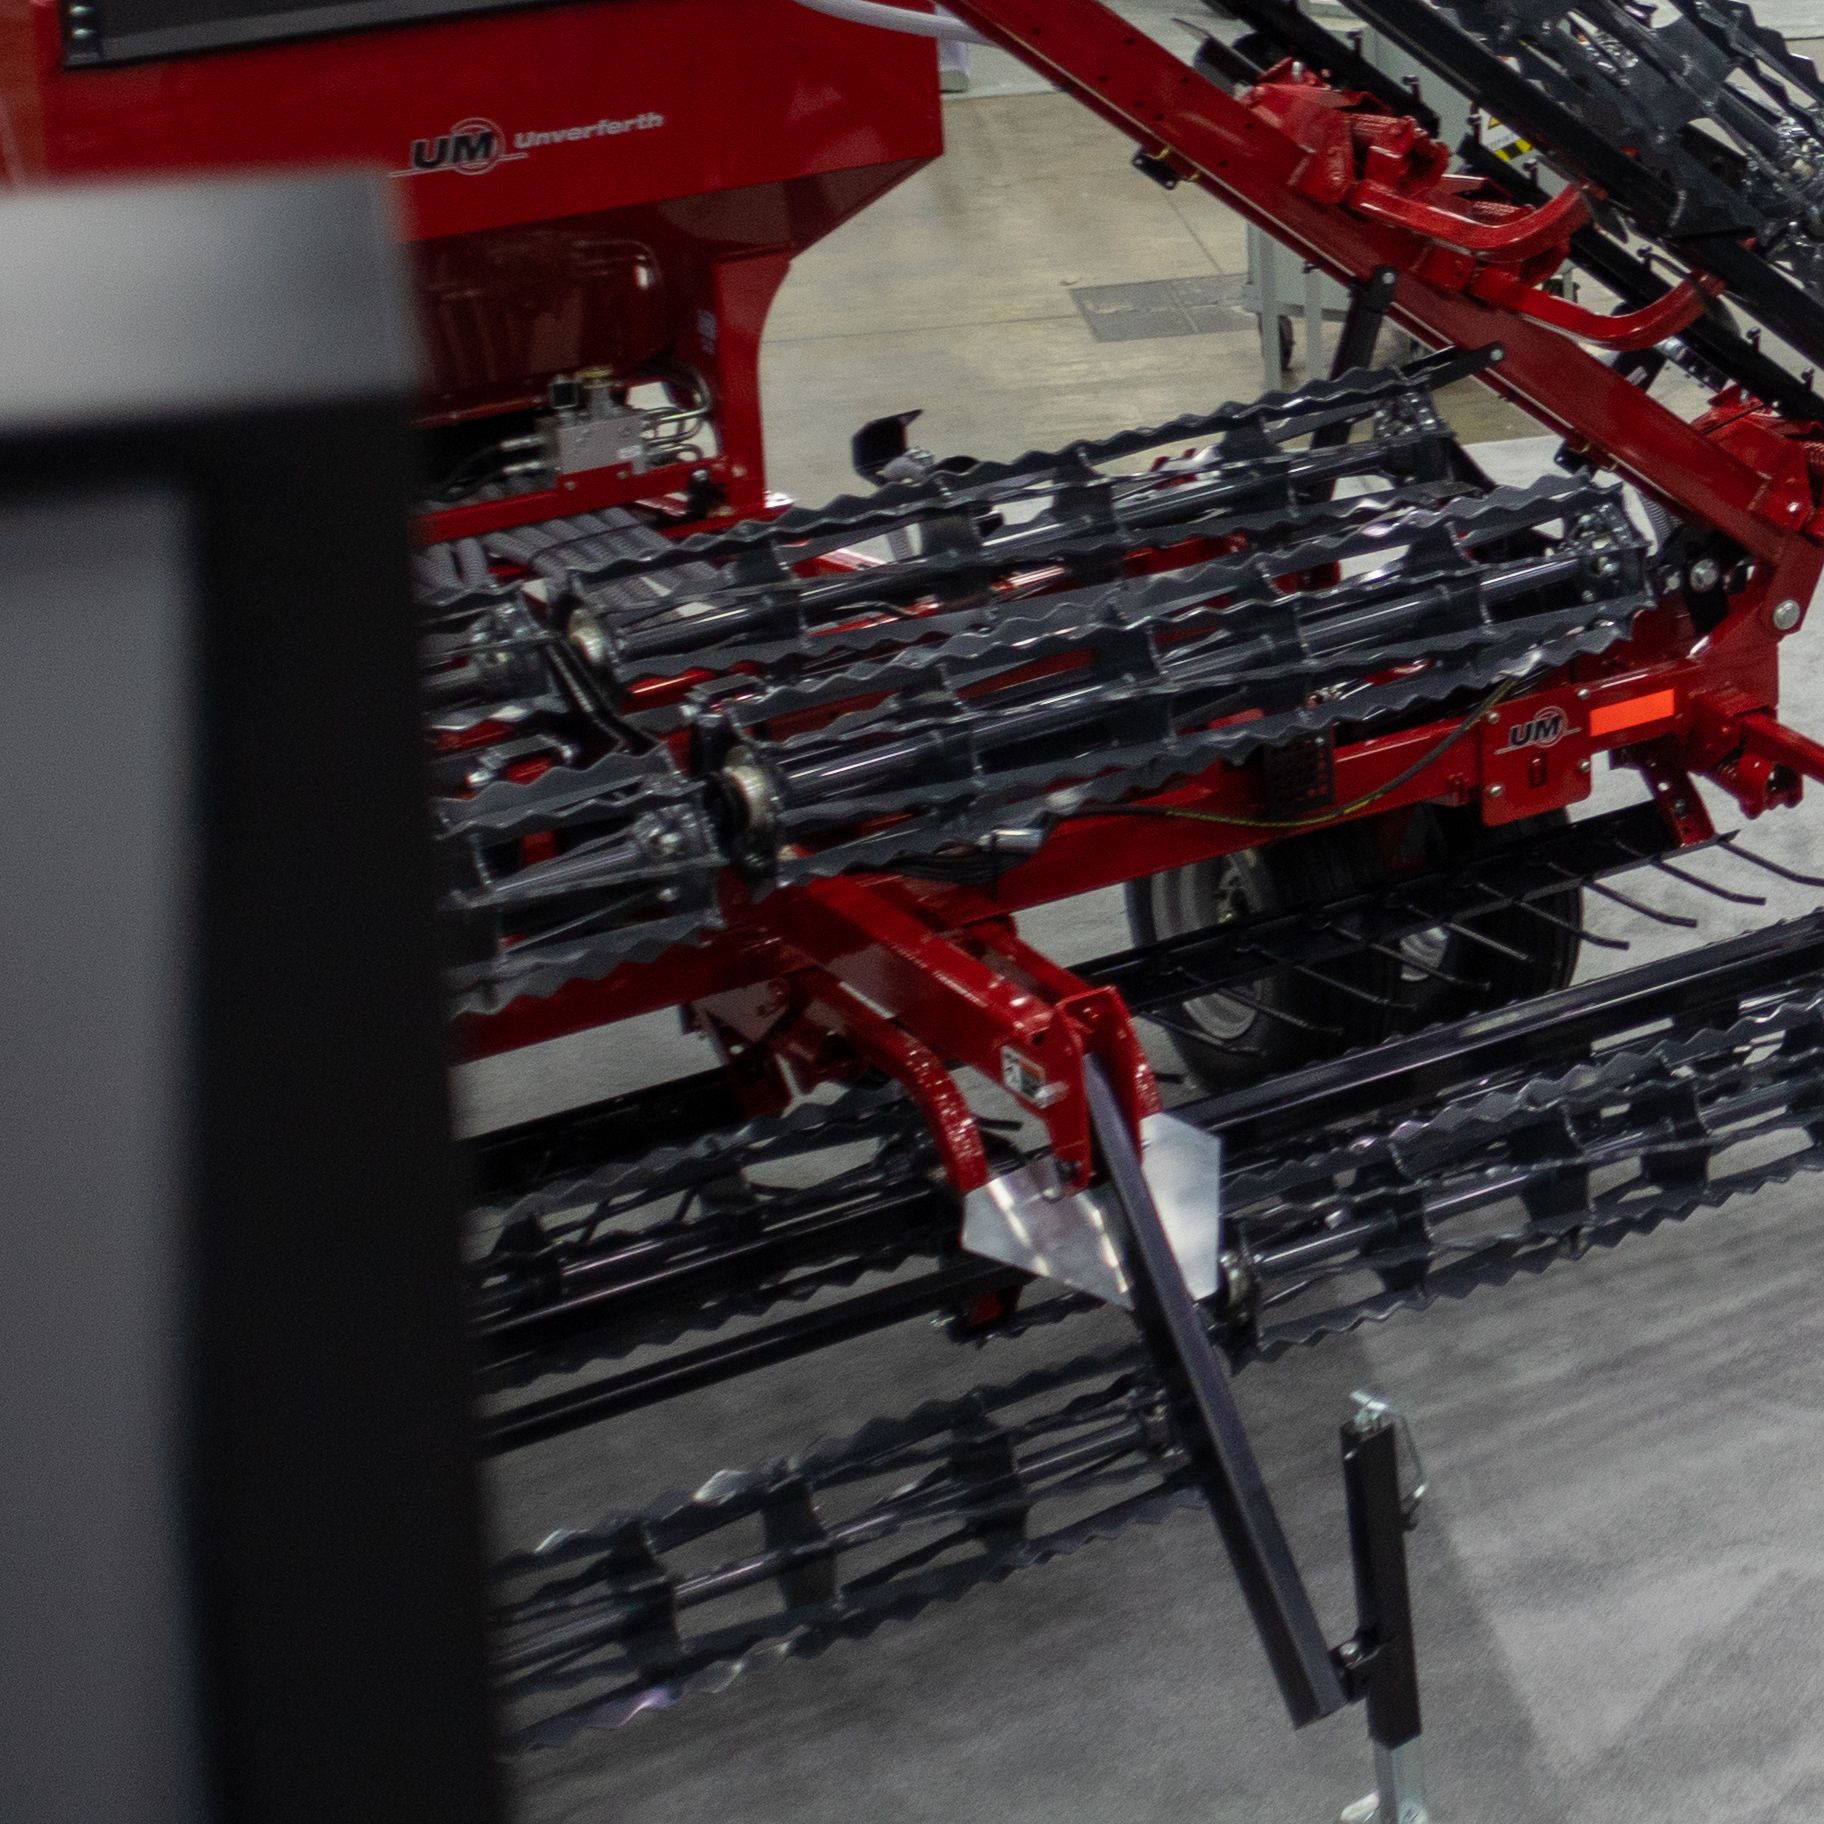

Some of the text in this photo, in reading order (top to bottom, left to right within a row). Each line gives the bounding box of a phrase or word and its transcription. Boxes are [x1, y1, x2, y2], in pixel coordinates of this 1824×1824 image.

[411, 111, 665, 169] UM Unverferth
[1508, 712, 1566, 752] UM
